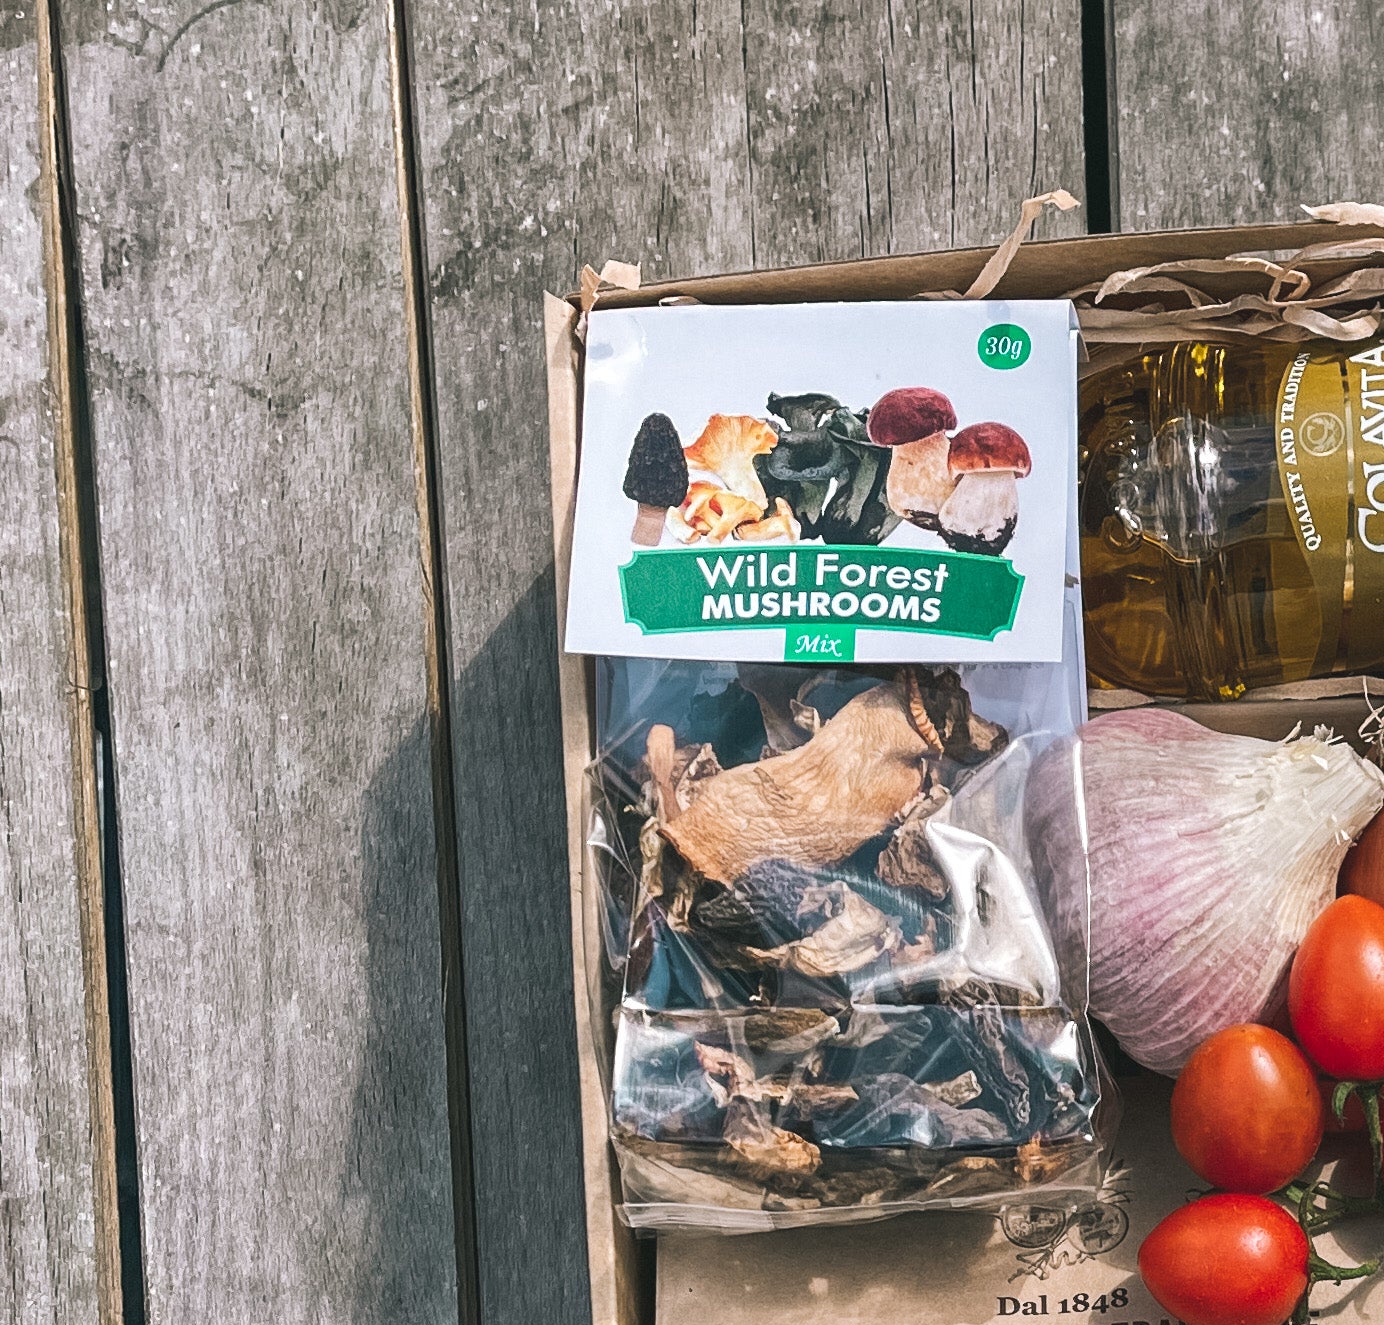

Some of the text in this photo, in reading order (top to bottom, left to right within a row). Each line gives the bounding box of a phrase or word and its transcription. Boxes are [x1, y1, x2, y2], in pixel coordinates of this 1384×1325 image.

[985, 336, 1023, 360] 30g
[1280, 352, 1322, 551] QUALITY AND TRADITION
[696, 553, 949, 593] Wild Forest
[702, 592, 941, 623] MUSHROOMS
[795, 634, 842, 657] Mix
[997, 1286, 1129, 1317] Dal 1848
